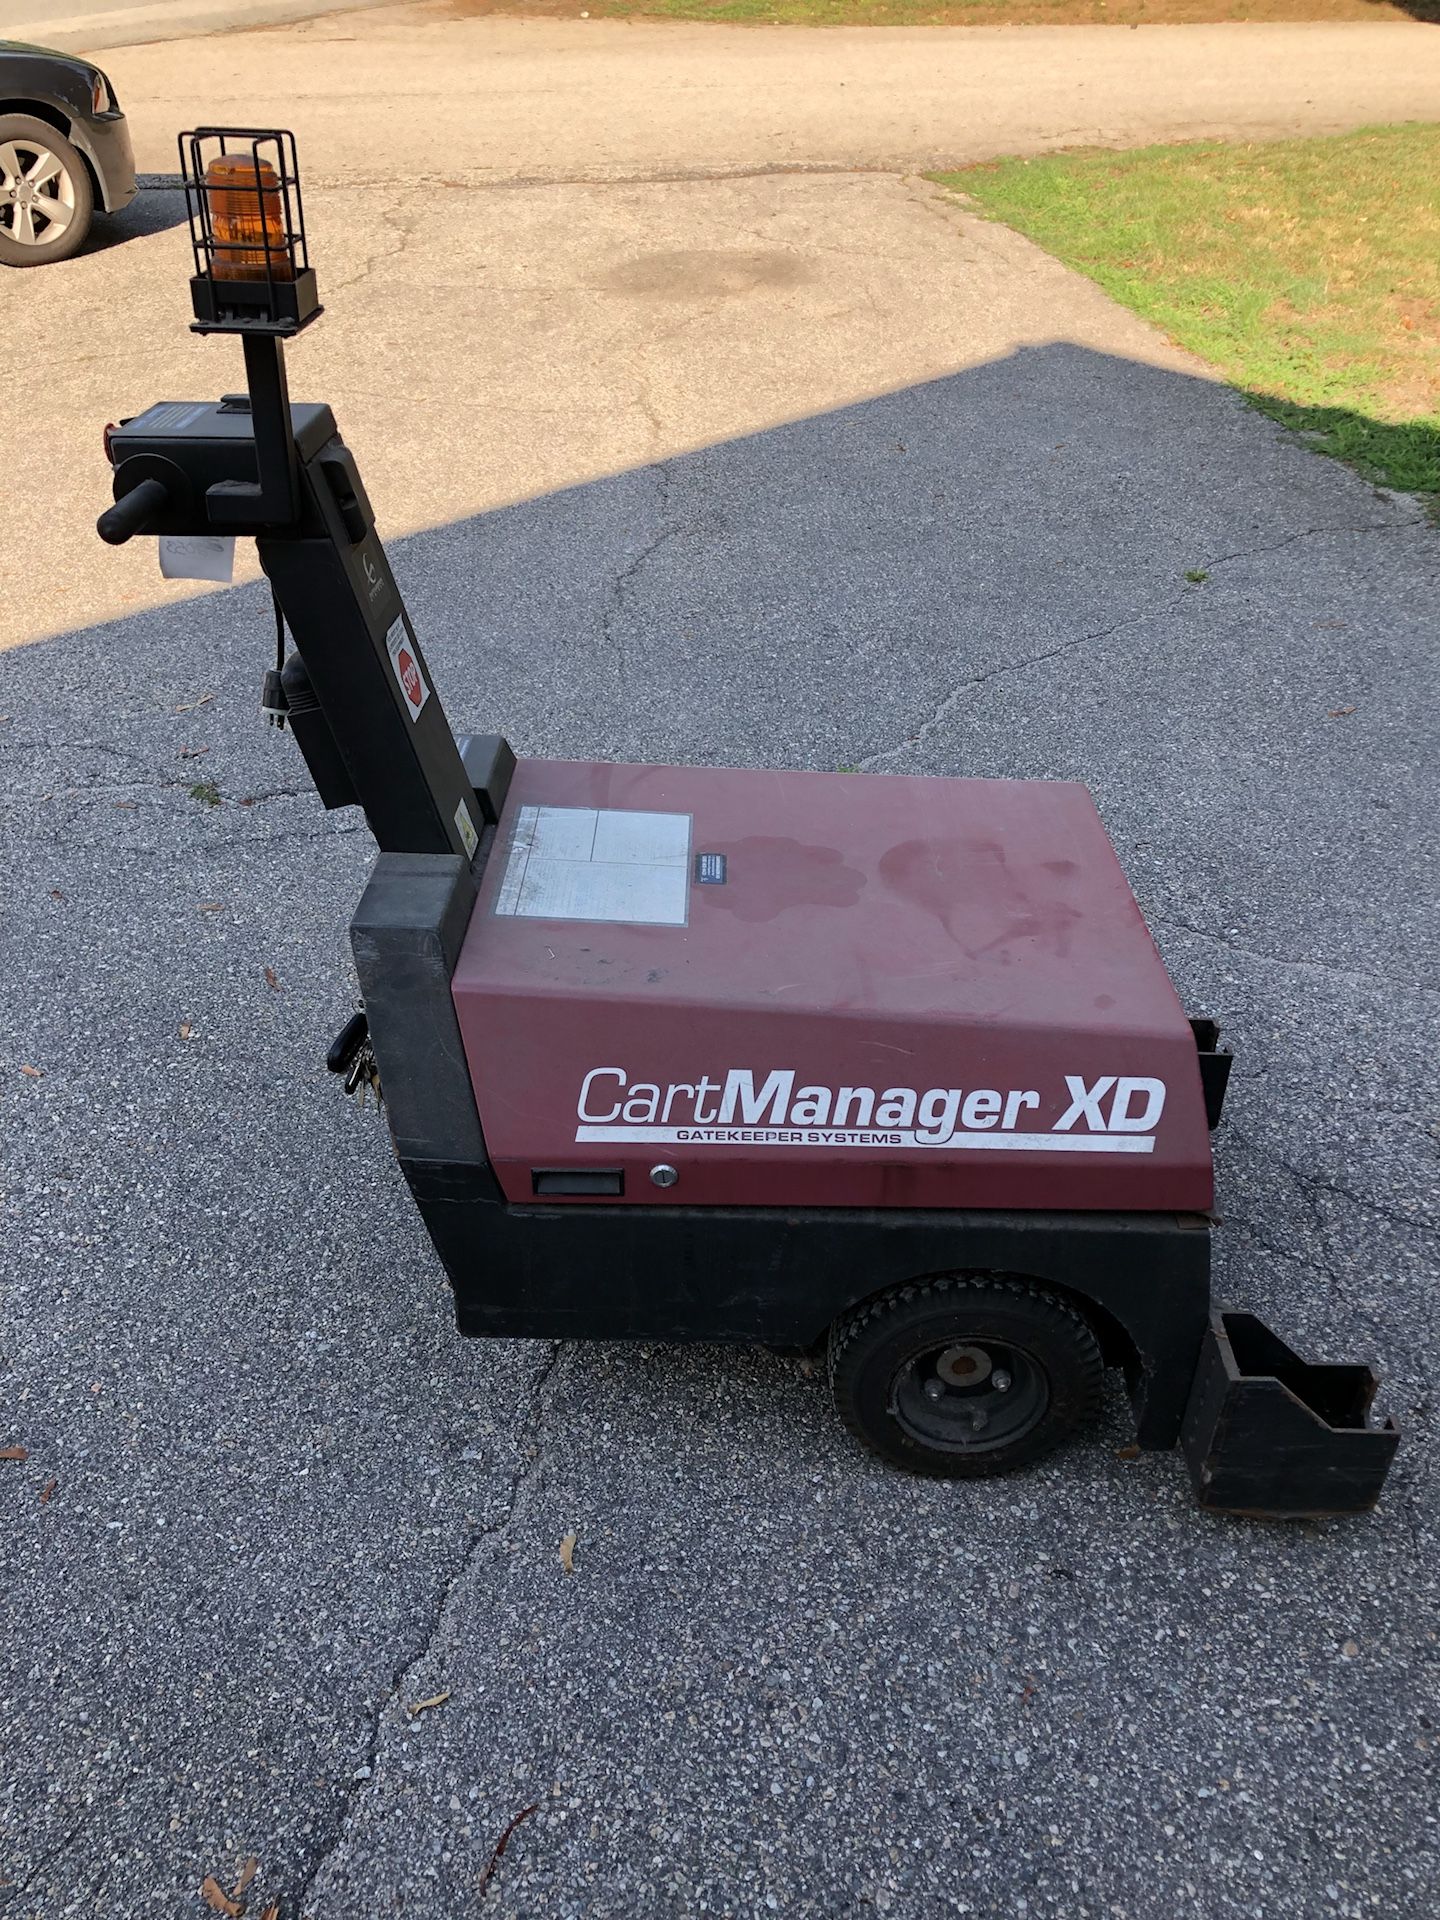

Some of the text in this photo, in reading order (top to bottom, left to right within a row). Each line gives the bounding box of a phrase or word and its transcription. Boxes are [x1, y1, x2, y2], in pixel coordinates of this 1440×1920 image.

[402, 661, 418, 696] STOP
[577, 1067, 1167, 1144] CartManager XD
[676, 1130, 902, 1145] GATEKEEPER SYSTEMS
